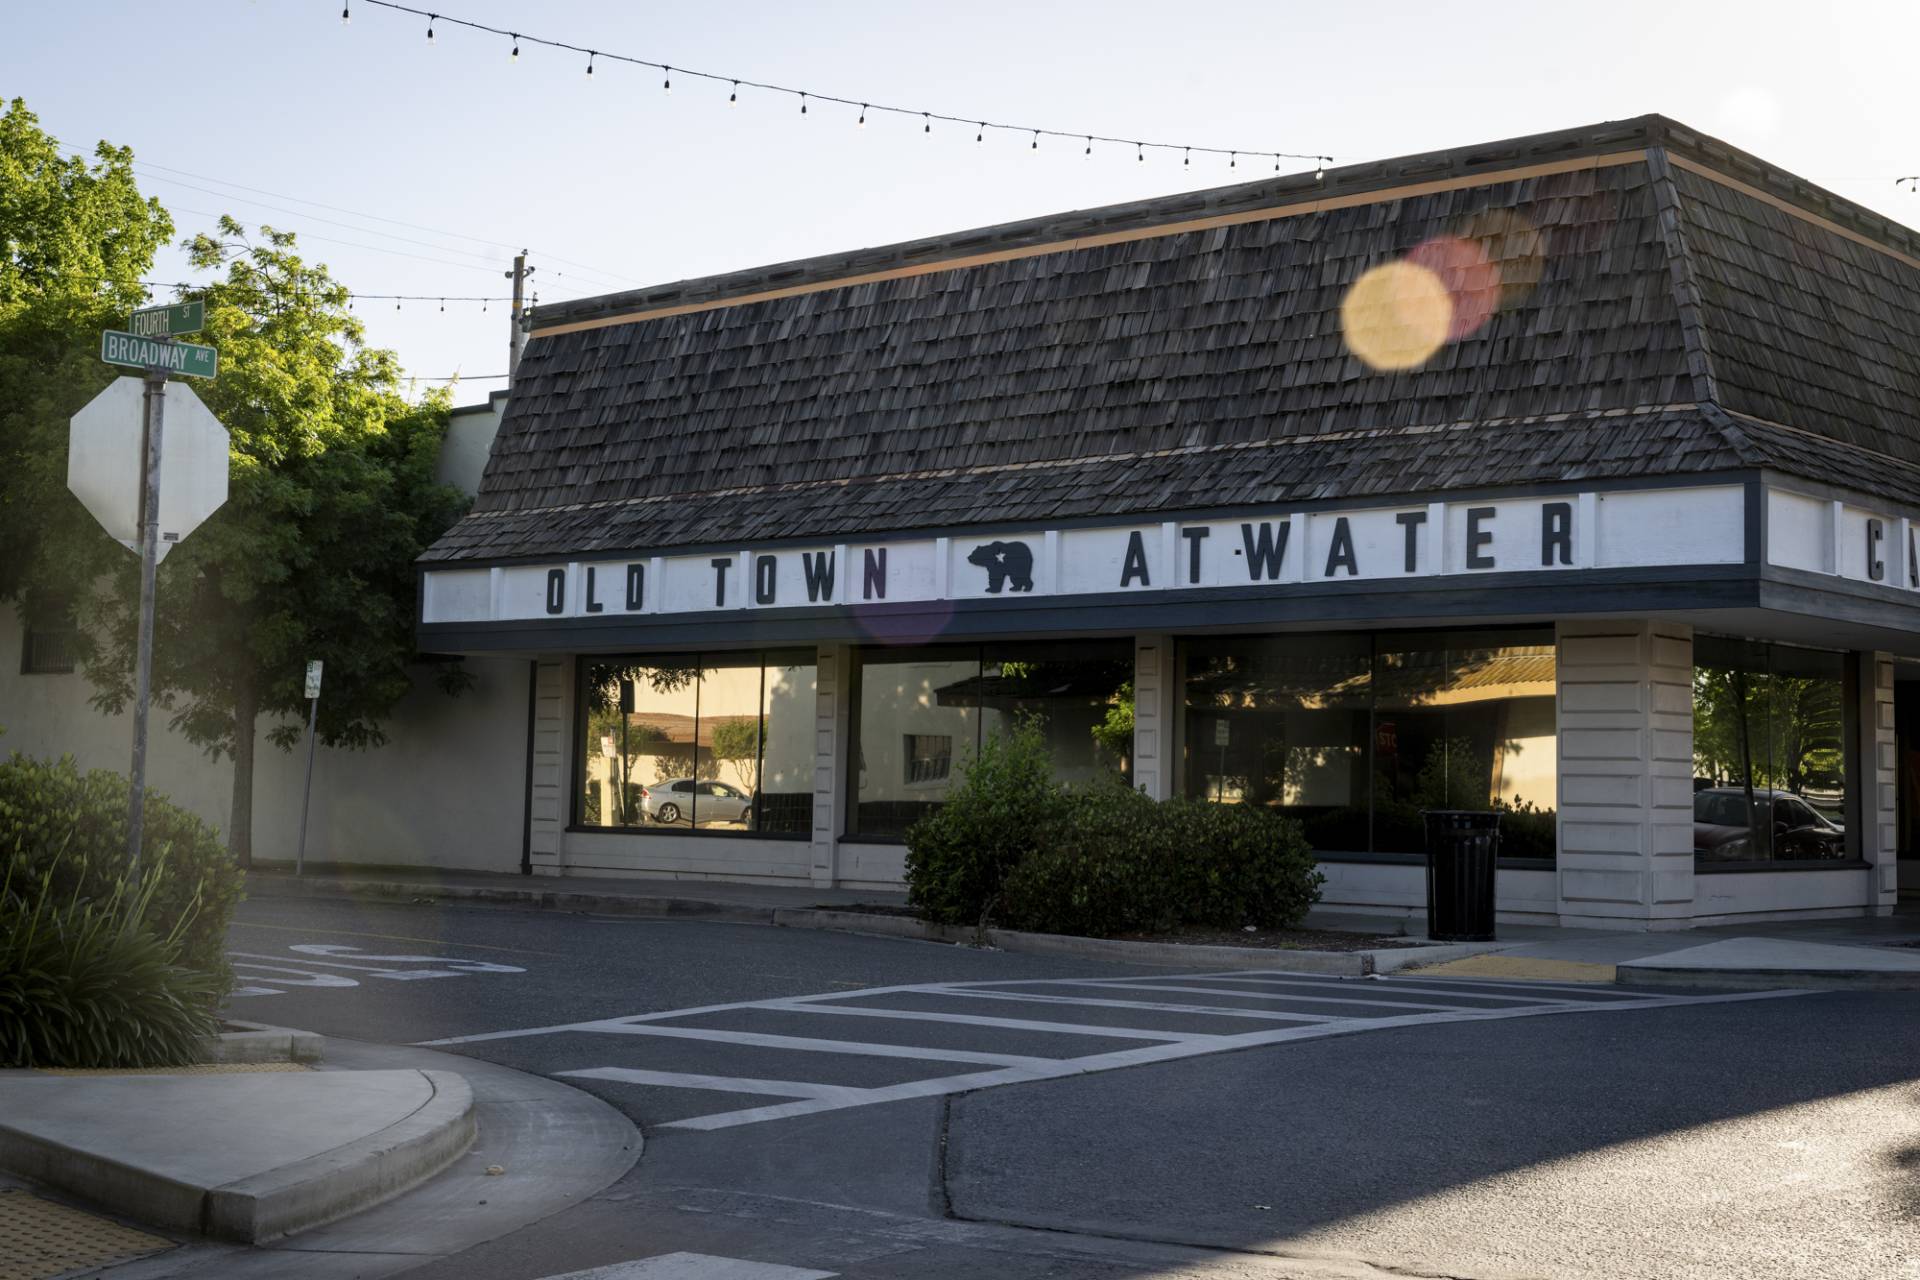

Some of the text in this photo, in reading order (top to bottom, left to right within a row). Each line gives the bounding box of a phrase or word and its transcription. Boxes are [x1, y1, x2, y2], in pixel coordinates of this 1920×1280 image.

[134, 305, 190, 336] FOURTH ST
[108, 335, 209, 370] BROADWAY AVE
[546, 502, 1573, 615] OLD TOWN ATWATER
